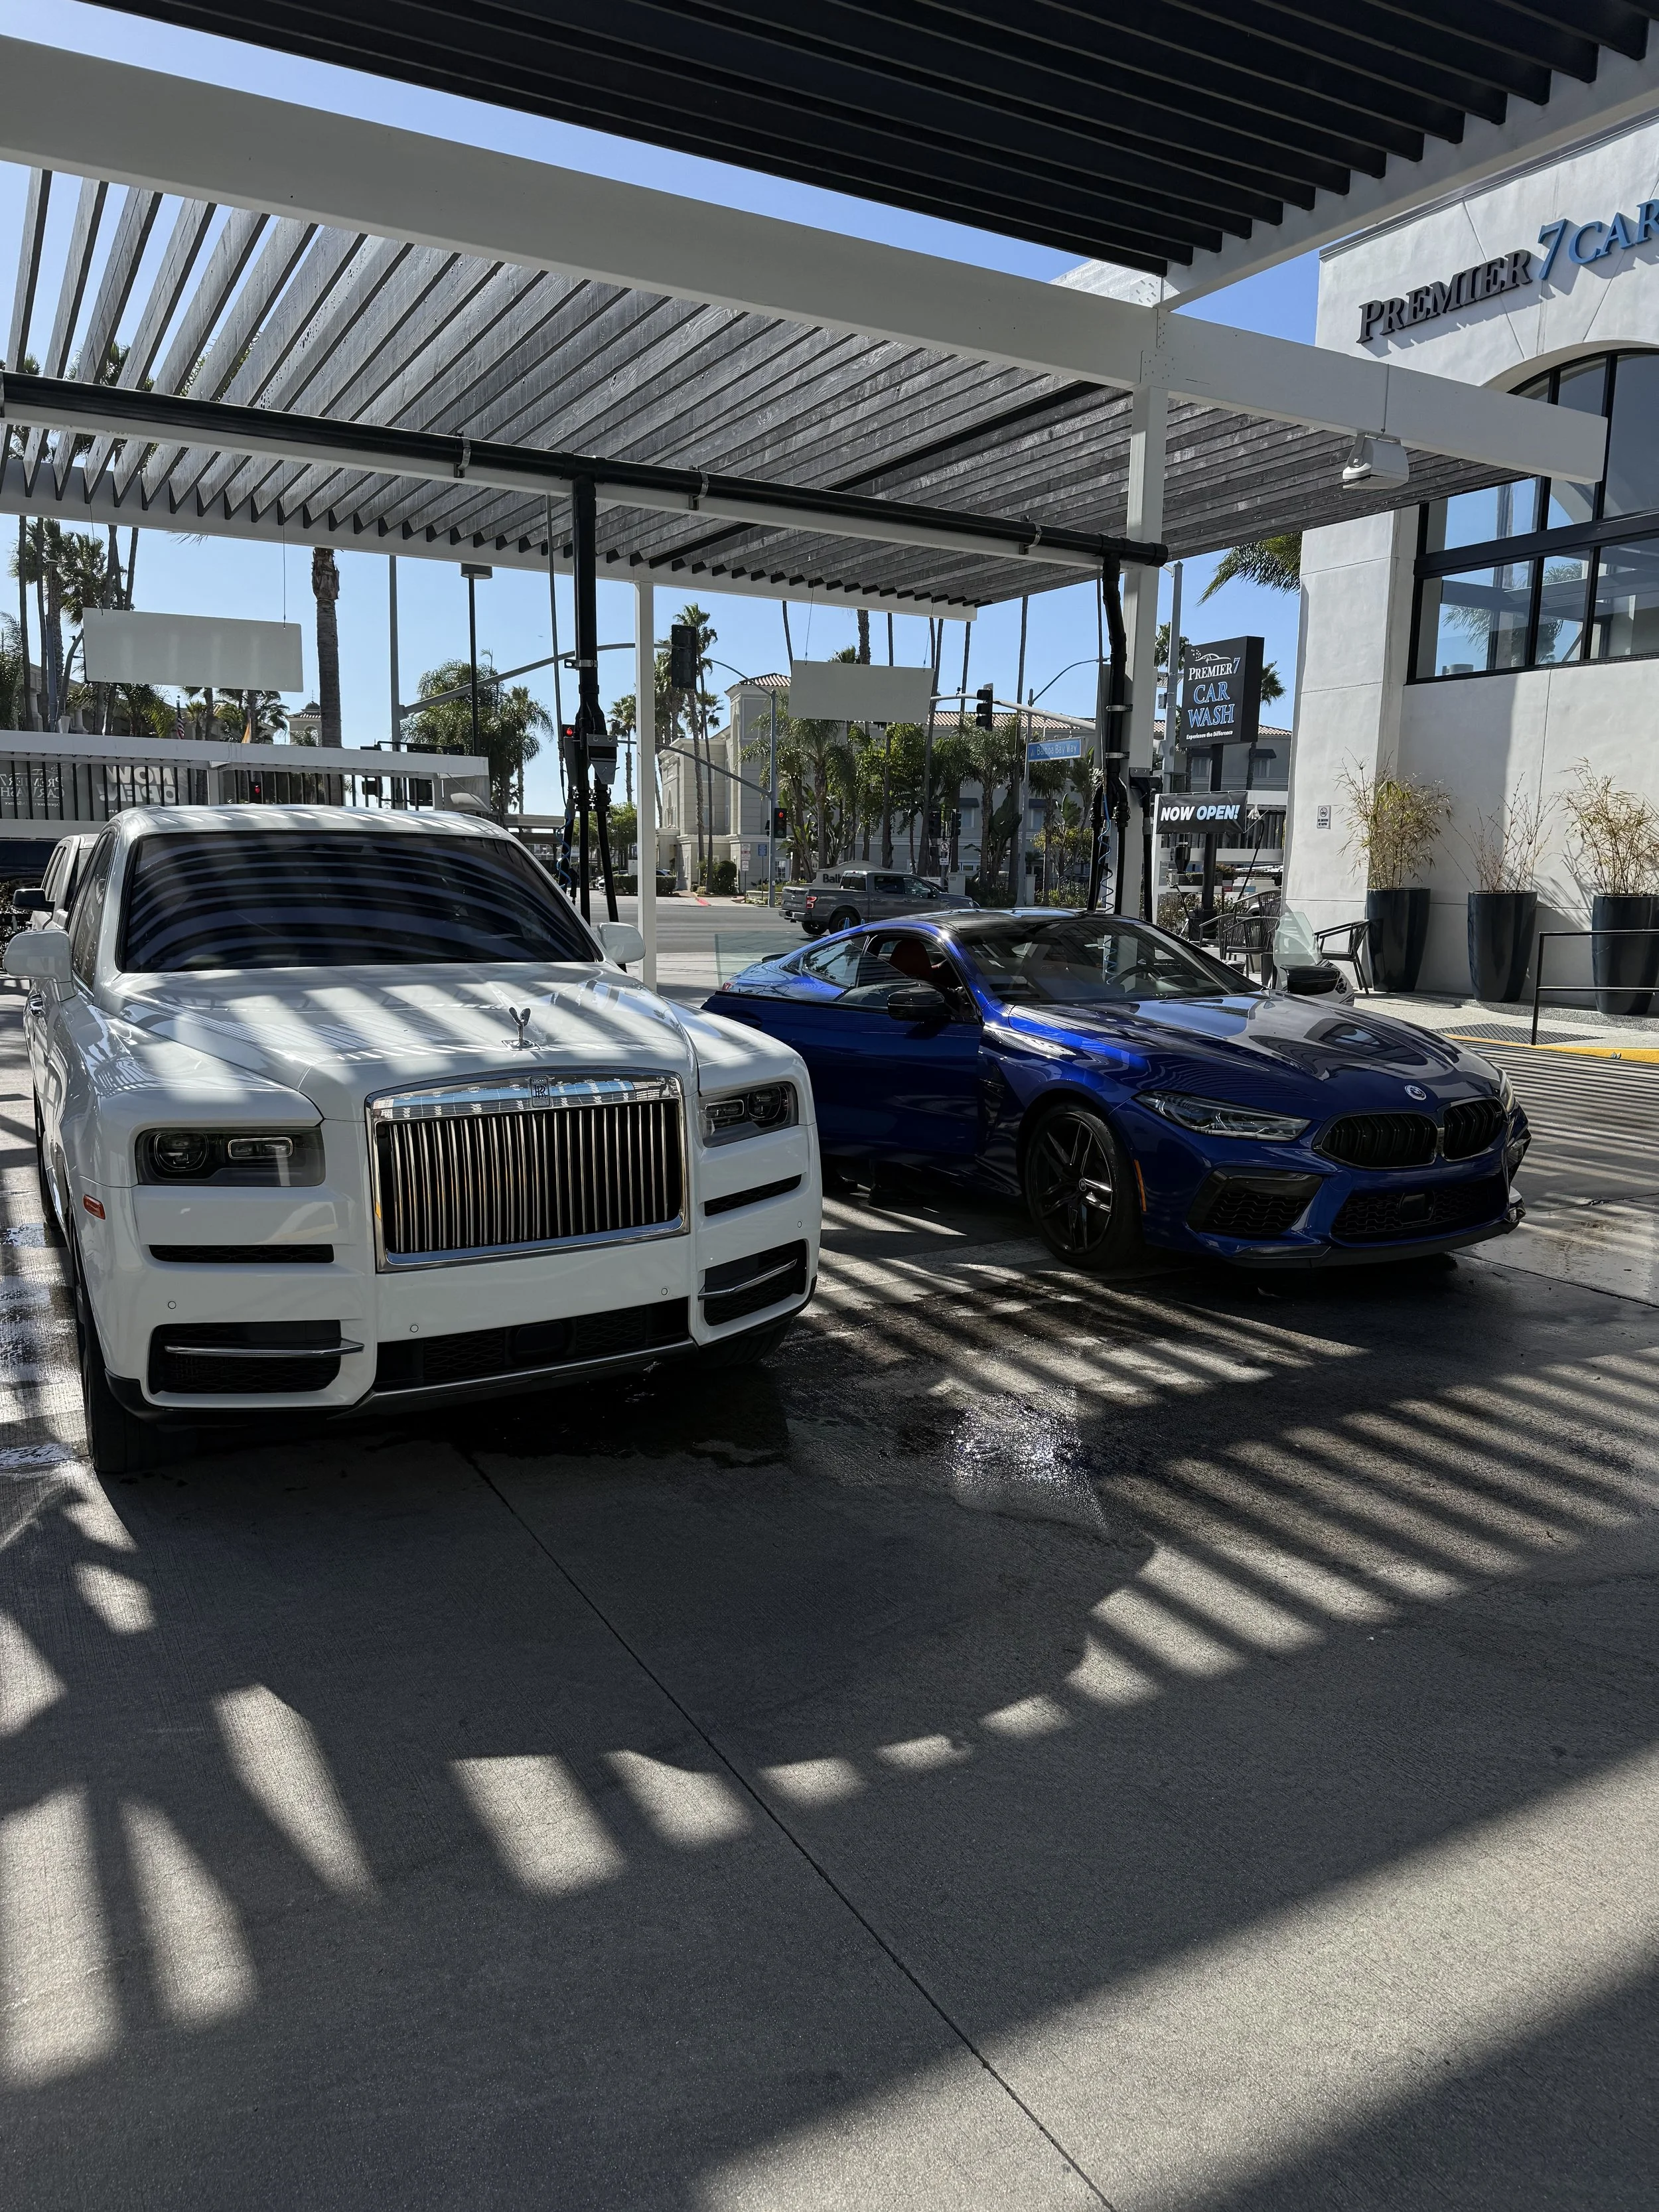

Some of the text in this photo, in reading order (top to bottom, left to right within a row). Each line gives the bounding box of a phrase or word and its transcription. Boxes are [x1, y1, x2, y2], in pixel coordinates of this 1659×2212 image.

[1356, 249, 1533, 344] PREMIER
[1193, 682, 1230, 704] CAR
[1188, 703, 1235, 728] WASH
[1037, 743, 1077, 756] Balboa Bay Way
[1160, 804, 1240, 821] NOW OPEN!
